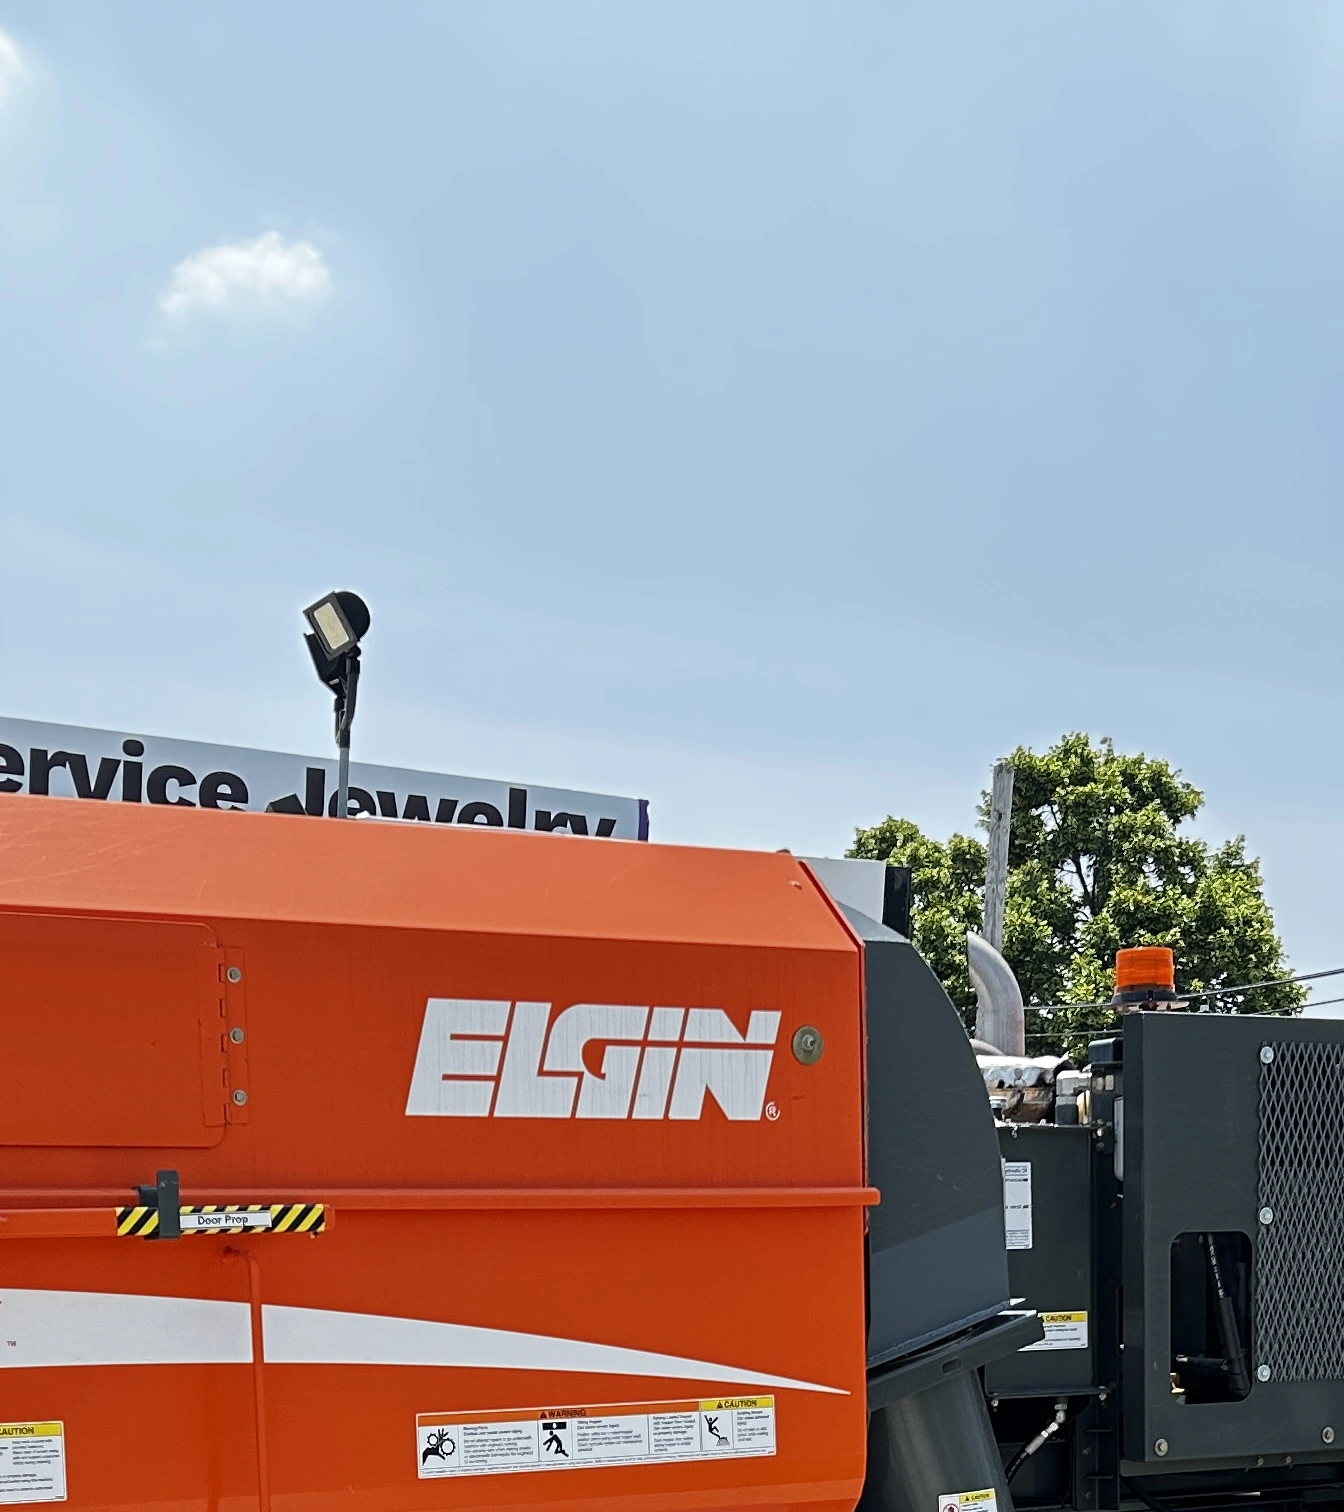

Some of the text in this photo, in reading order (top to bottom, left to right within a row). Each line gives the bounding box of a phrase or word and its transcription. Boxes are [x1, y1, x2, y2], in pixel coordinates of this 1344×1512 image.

[265, 767, 617, 836] Jewelr
[405, 998, 782, 1121] ELGIN
[197, 1214, 249, 1227] Door Prop
